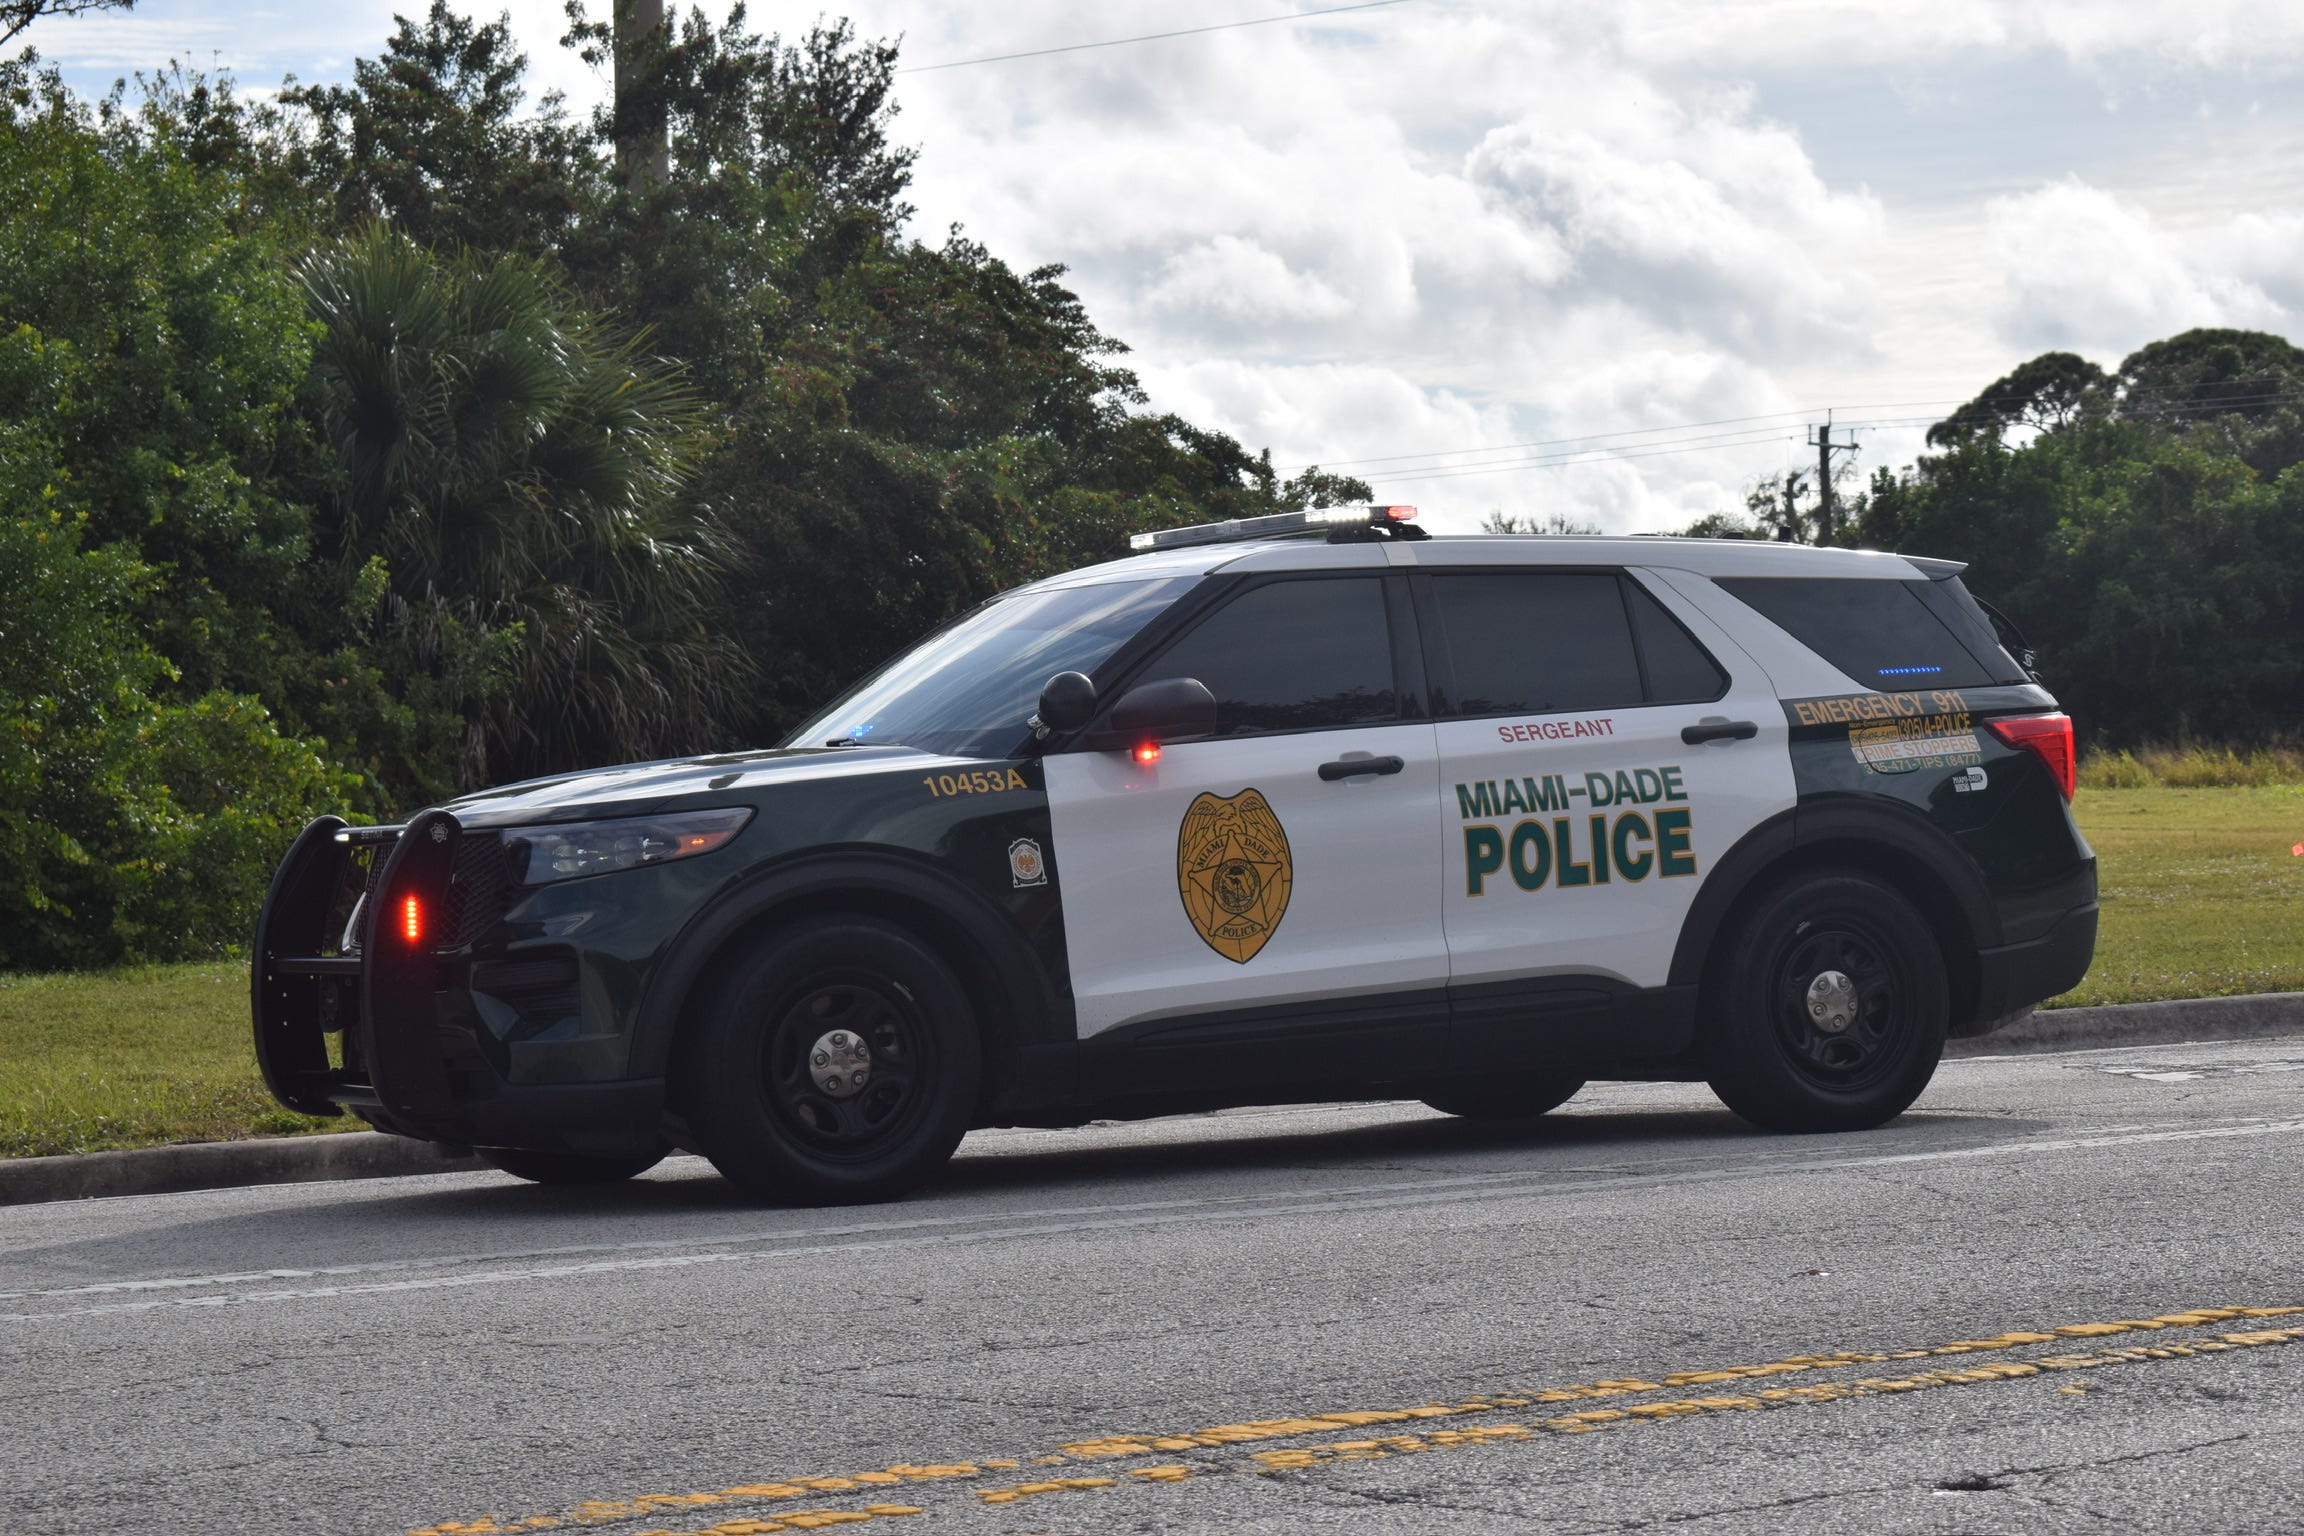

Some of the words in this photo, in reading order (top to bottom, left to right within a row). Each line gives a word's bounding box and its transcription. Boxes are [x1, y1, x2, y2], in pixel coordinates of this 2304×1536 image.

[1794, 692, 1925, 726] EMERGENCY
[1932, 691, 1969, 713] 911
[1498, 718, 1615, 743] SERGEANT
[1854, 743, 1902, 762] CRIME
[1904, 736, 1980, 757] STOPPERS
[1945, 752, 1981, 767] (8477)
[923, 768, 1028, 797] 10453A
[1455, 765, 1689, 819] MIAMI-DADE
[1952, 773, 1983, 785] MIAMI-DADE
[1197, 837, 1224, 869] MIAMI
[1244, 838, 1269, 858] DADE
[1463, 806, 1698, 898] POLICE
[1222, 923, 1258, 938] POLICE
